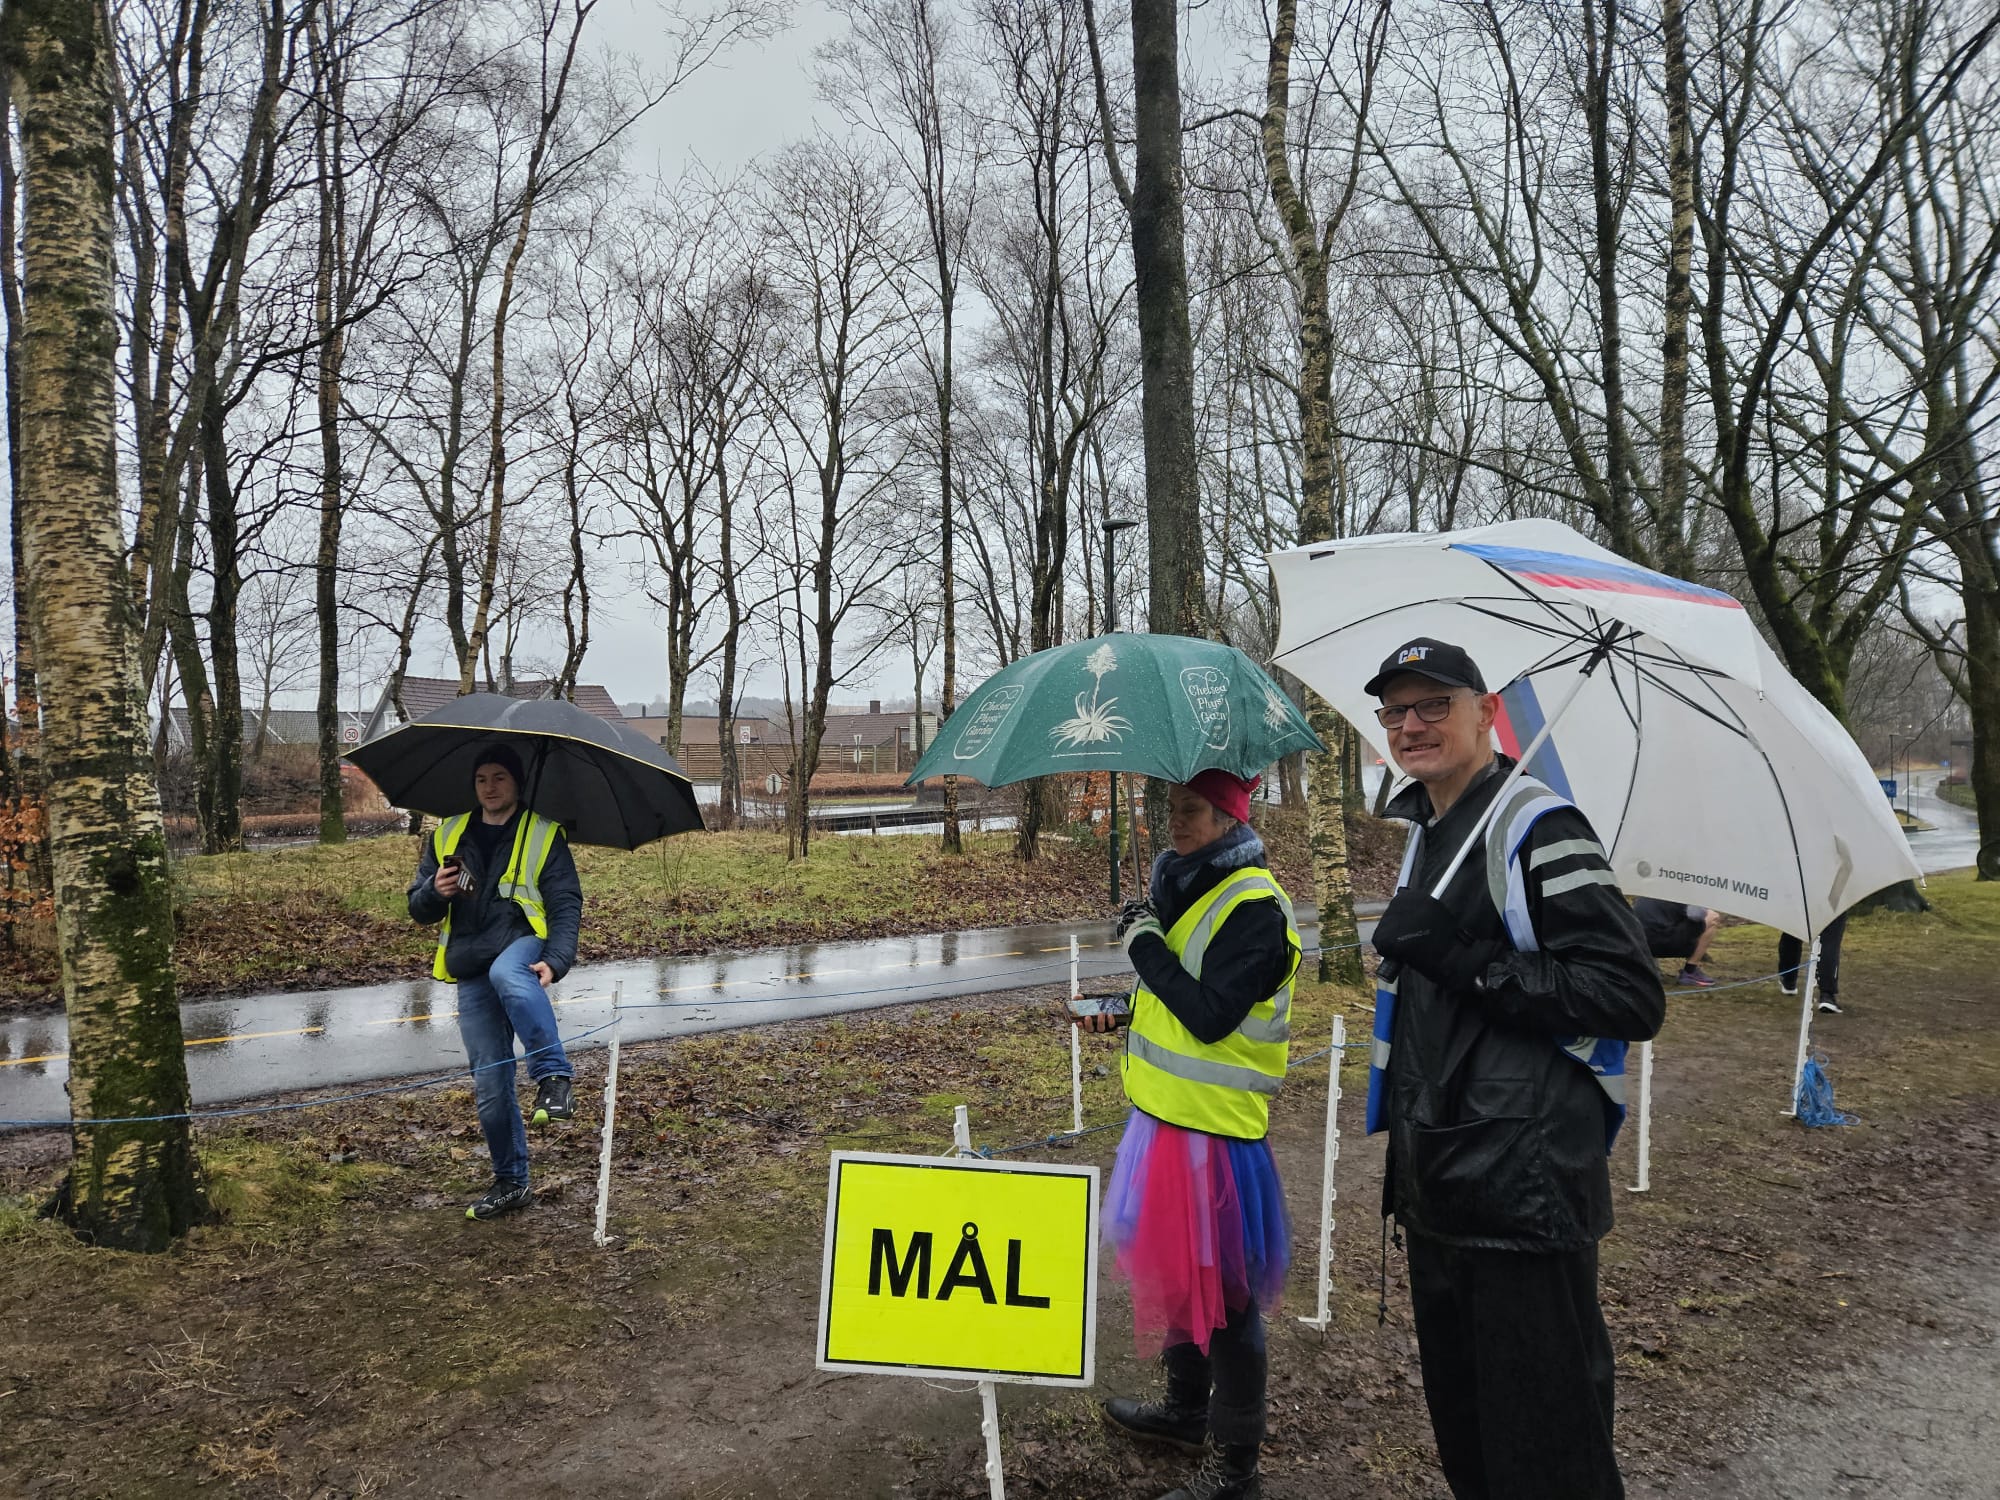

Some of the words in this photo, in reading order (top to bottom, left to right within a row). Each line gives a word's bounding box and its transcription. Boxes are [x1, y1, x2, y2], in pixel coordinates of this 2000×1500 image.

[1398, 646, 1429, 664] CAT
[1188, 684, 1228, 697] Chelsea
[867, 1221, 1051, 1310] MÅL
